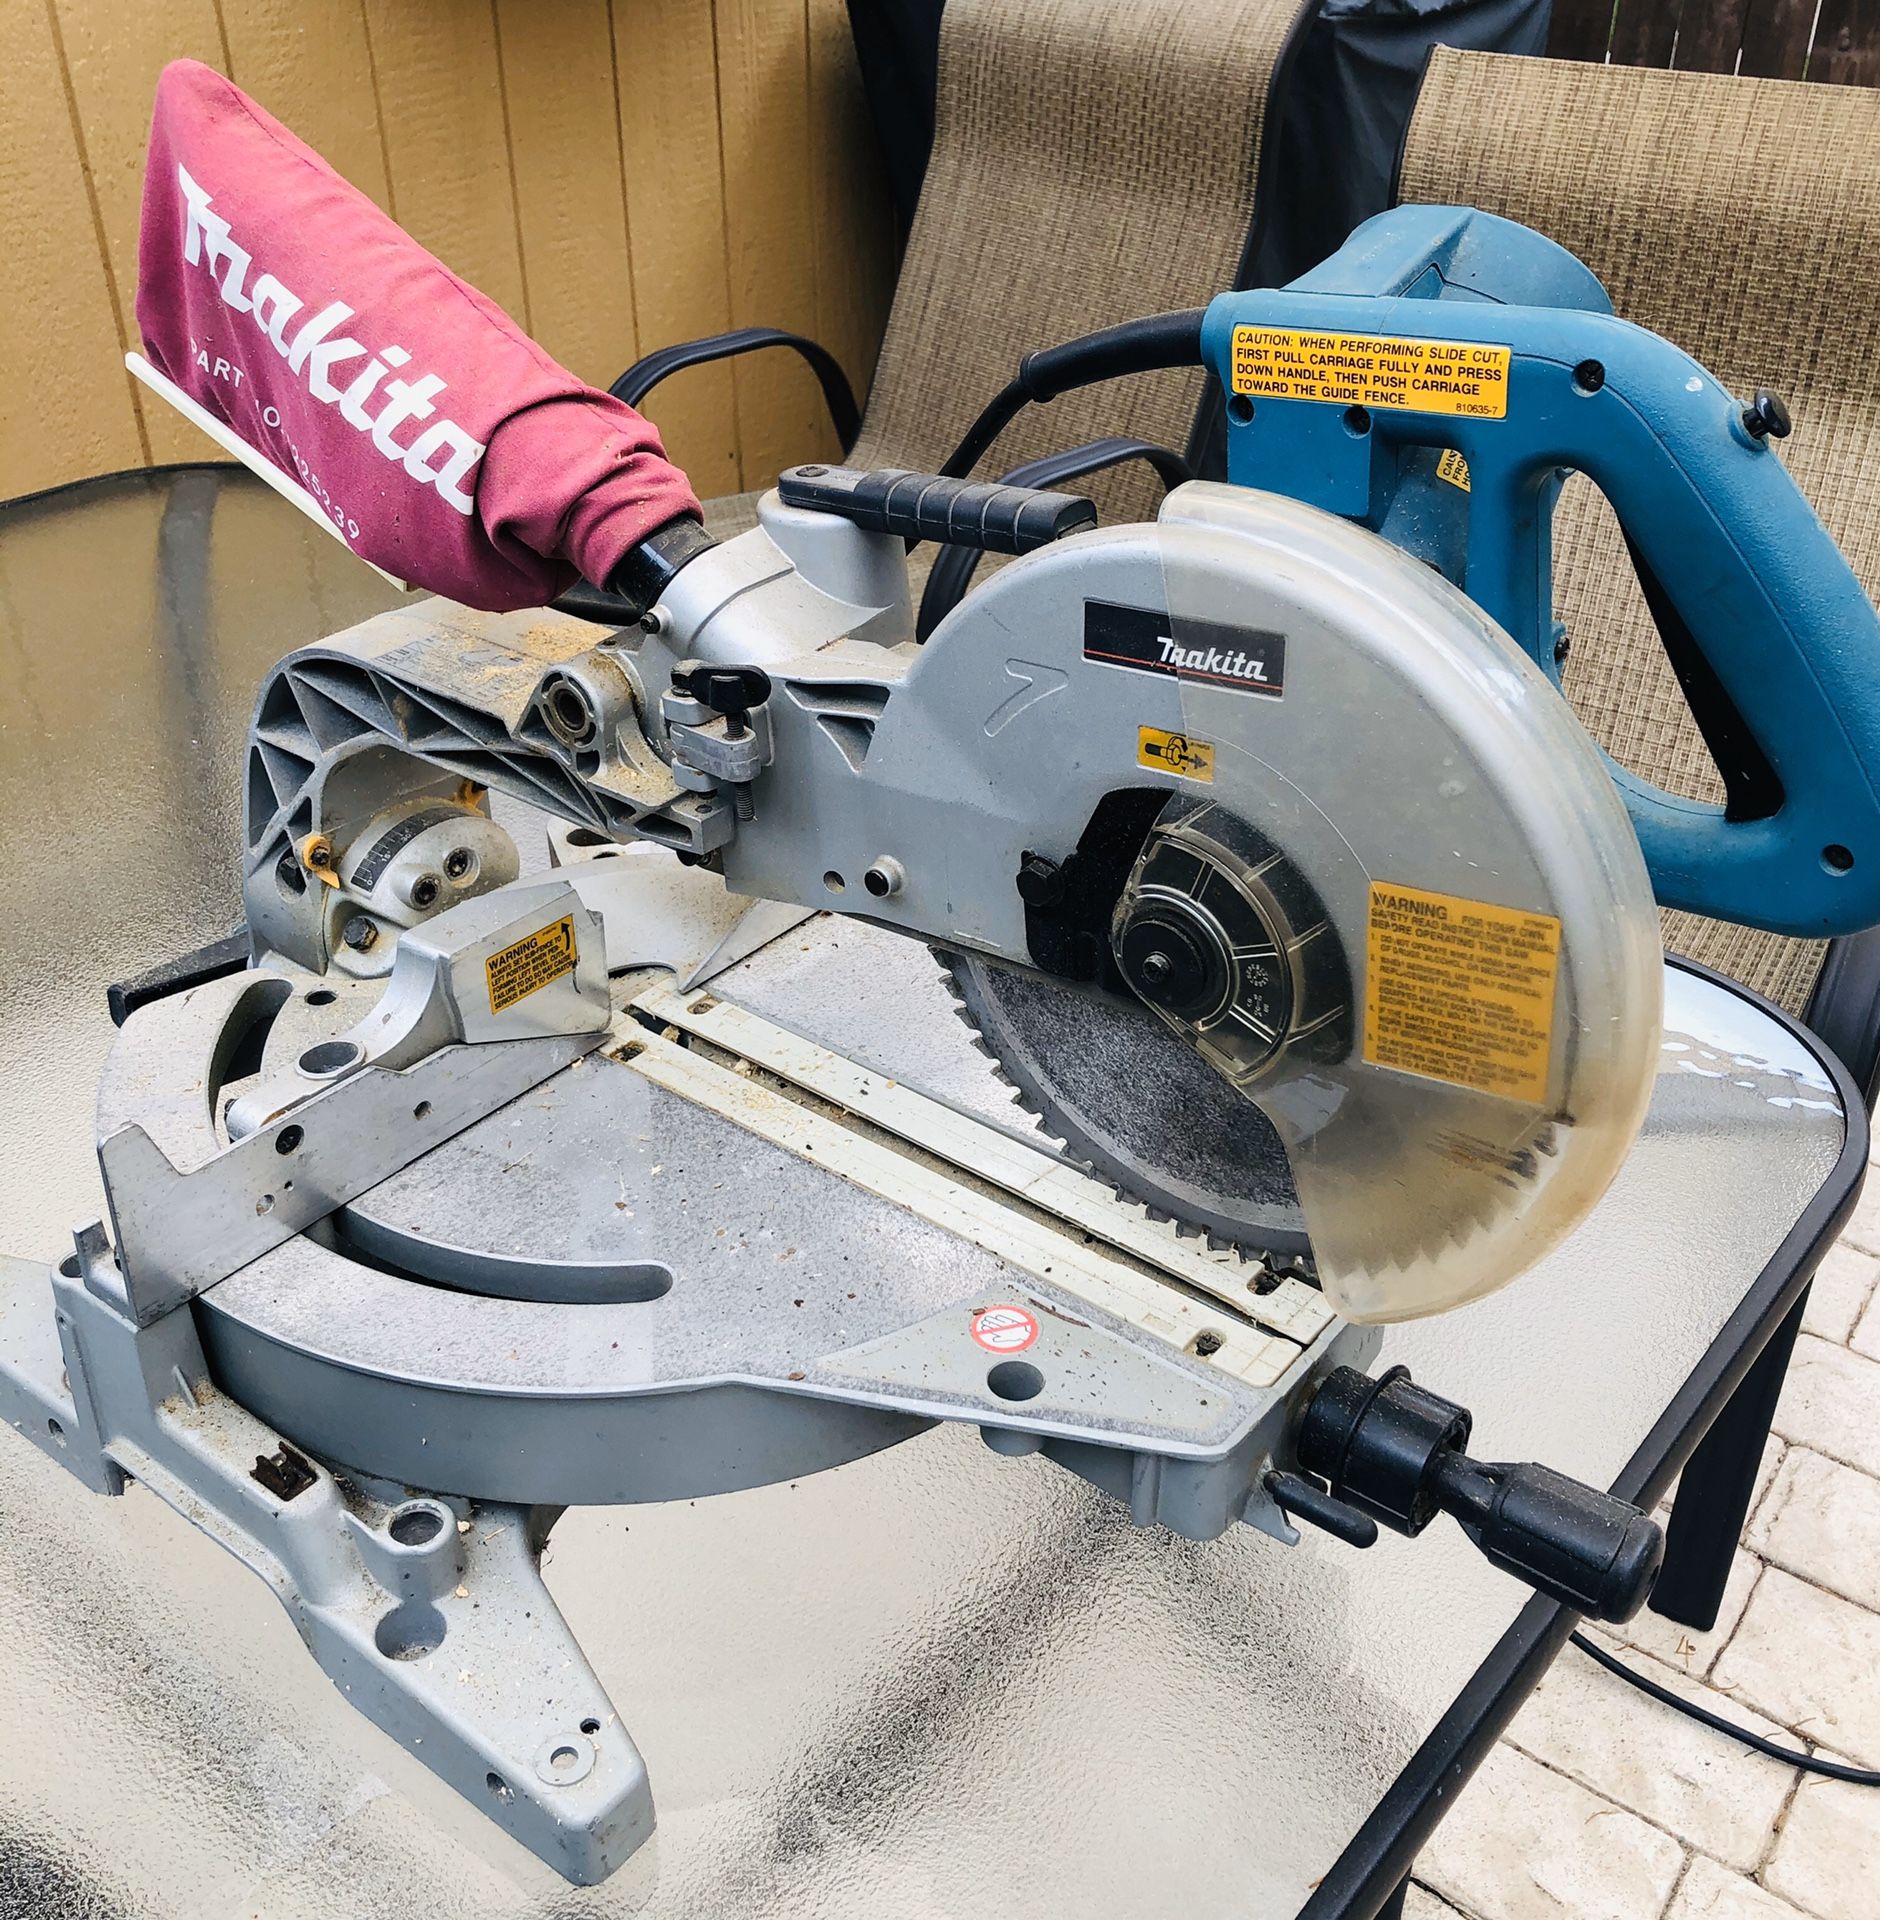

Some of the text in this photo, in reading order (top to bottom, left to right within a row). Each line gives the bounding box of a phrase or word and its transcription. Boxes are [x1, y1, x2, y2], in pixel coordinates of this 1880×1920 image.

[189, 336, 244, 388] PART
[1237, 331, 1502, 364] CAUTION: WHEN PERFORMING SLIDE CUT,
[1237, 347, 1501, 380] FIRST PULL CARRIAGE FULLY AND PRESS
[1237, 363, 1479, 395] DOWN HANDLE, THEN PUSH CARRIAGE
[1237, 378, 1408, 405] TOWARD THE GUIDE FENCE.
[1455, 402, 1498, 415] 810635-7
[1371, 892, 1447, 920] WARNING
[1461, 914, 1482, 928] FOR
[1486, 920, 1516, 934] YOUR
[1518, 926, 1544, 940] OWN
[1371, 908, 1408, 923] SAFETY
[1411, 916, 1438, 929] READ
[1440, 922, 1508, 944] INSTRUCTION
[554, 935, 561, 943] TO
[1371, 918, 1411, 935] BEFORE
[1415, 927, 1474, 948] OPERATING
[1478, 940, 1502, 954] THIS
[488, 937, 537, 970] WARNING
[491, 975, 505, 985] LEFT
[506, 961, 530, 977] POSITION
